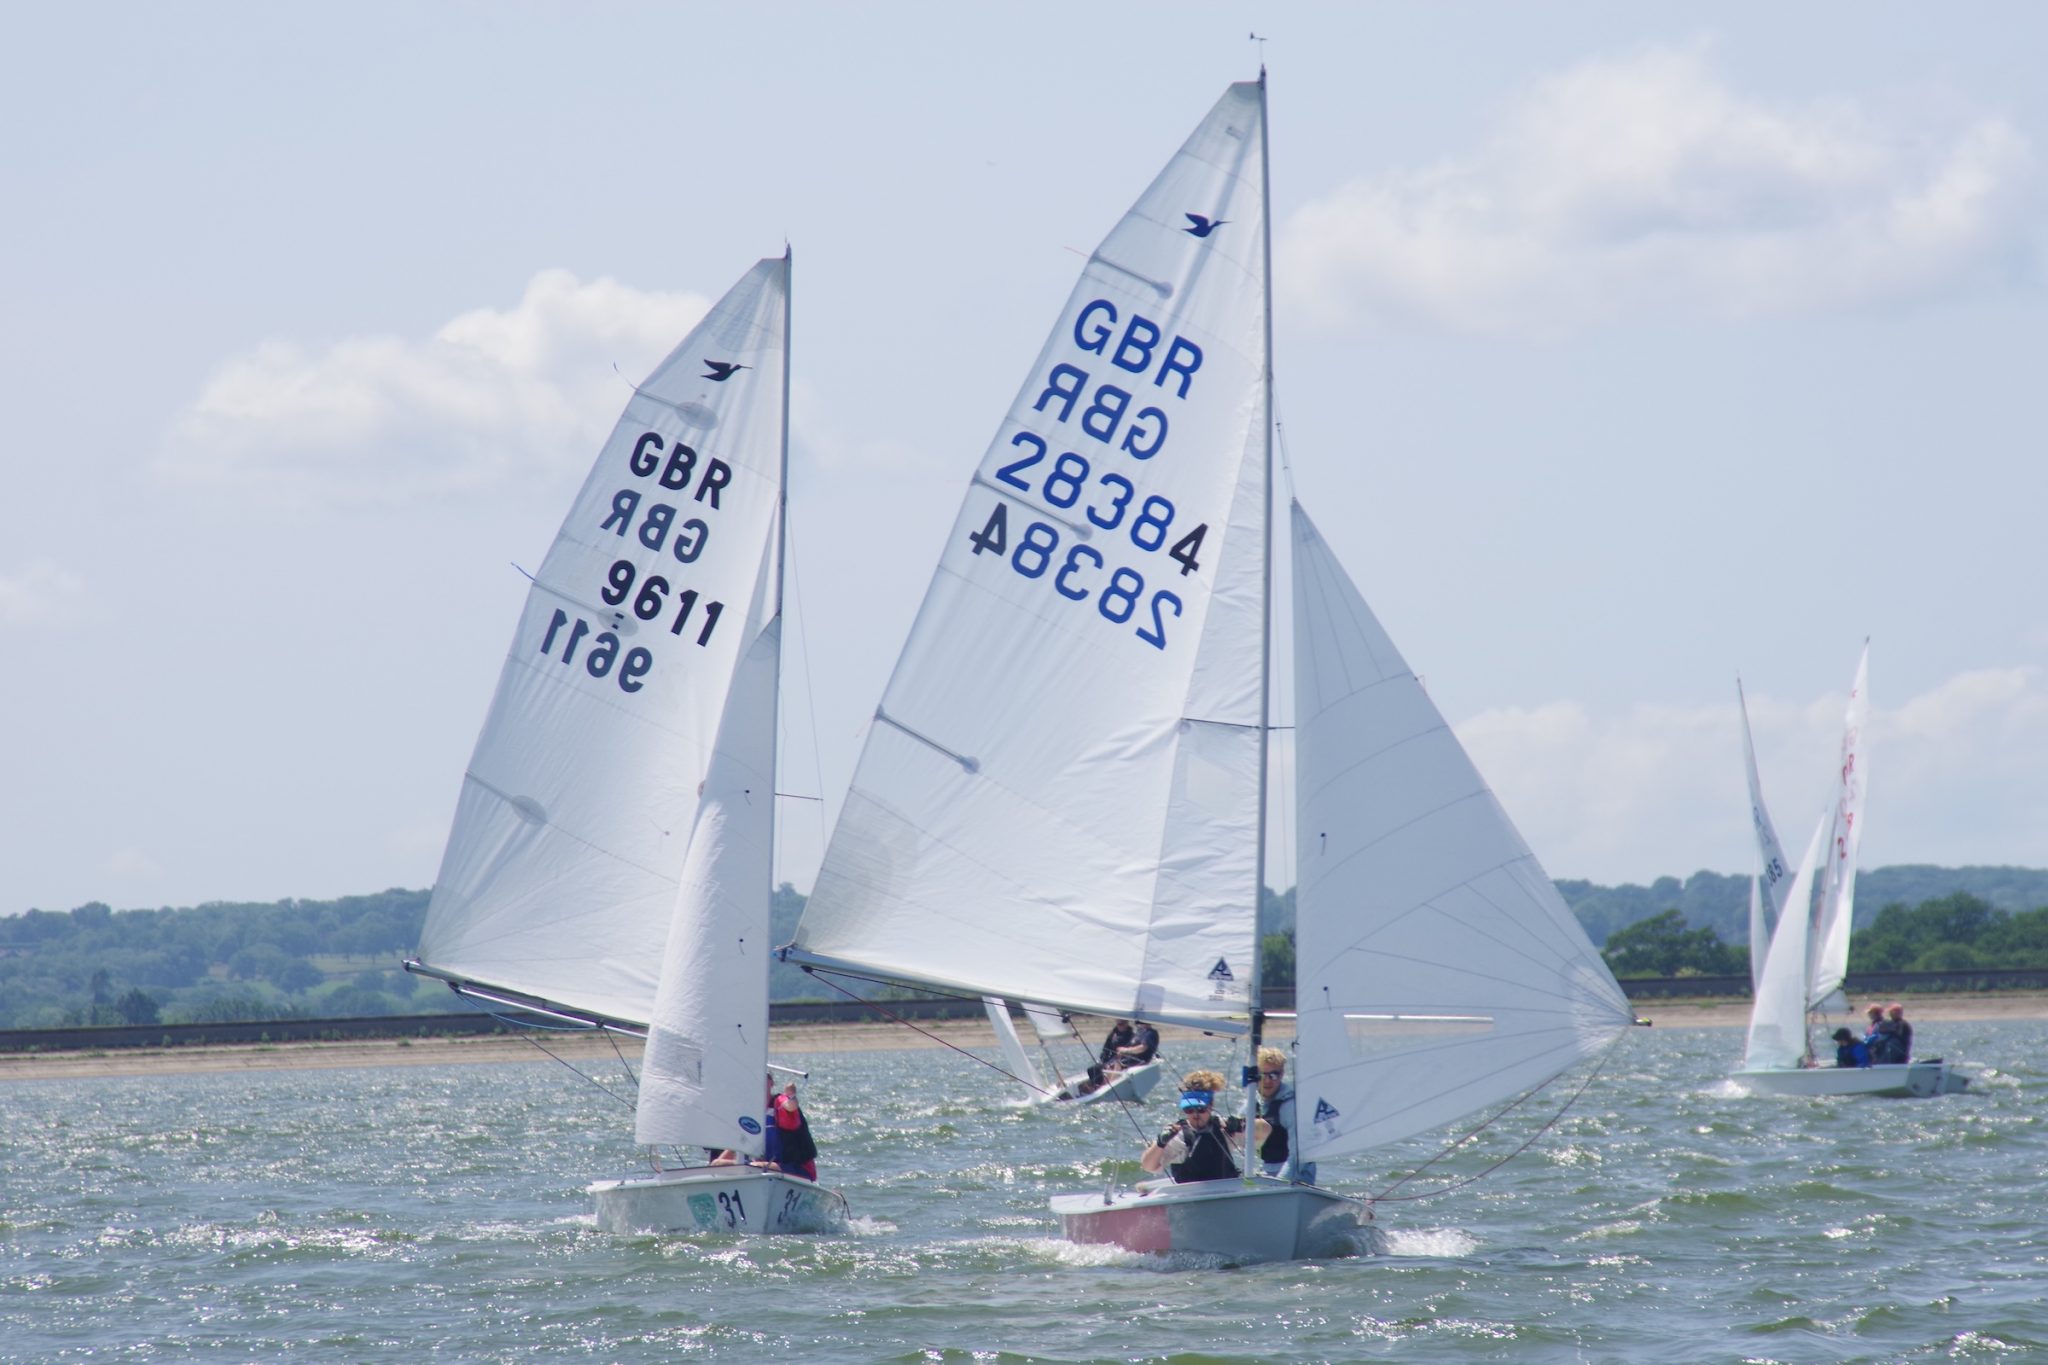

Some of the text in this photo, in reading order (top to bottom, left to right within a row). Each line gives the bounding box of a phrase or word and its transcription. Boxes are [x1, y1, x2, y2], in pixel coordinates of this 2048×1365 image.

[1074, 299, 1203, 400] GBR
[630, 432, 732, 510] GBR
[996, 431, 1208, 577] 28384
[601, 560, 724, 647] 9611
[718, 1189, 746, 1228] 31
